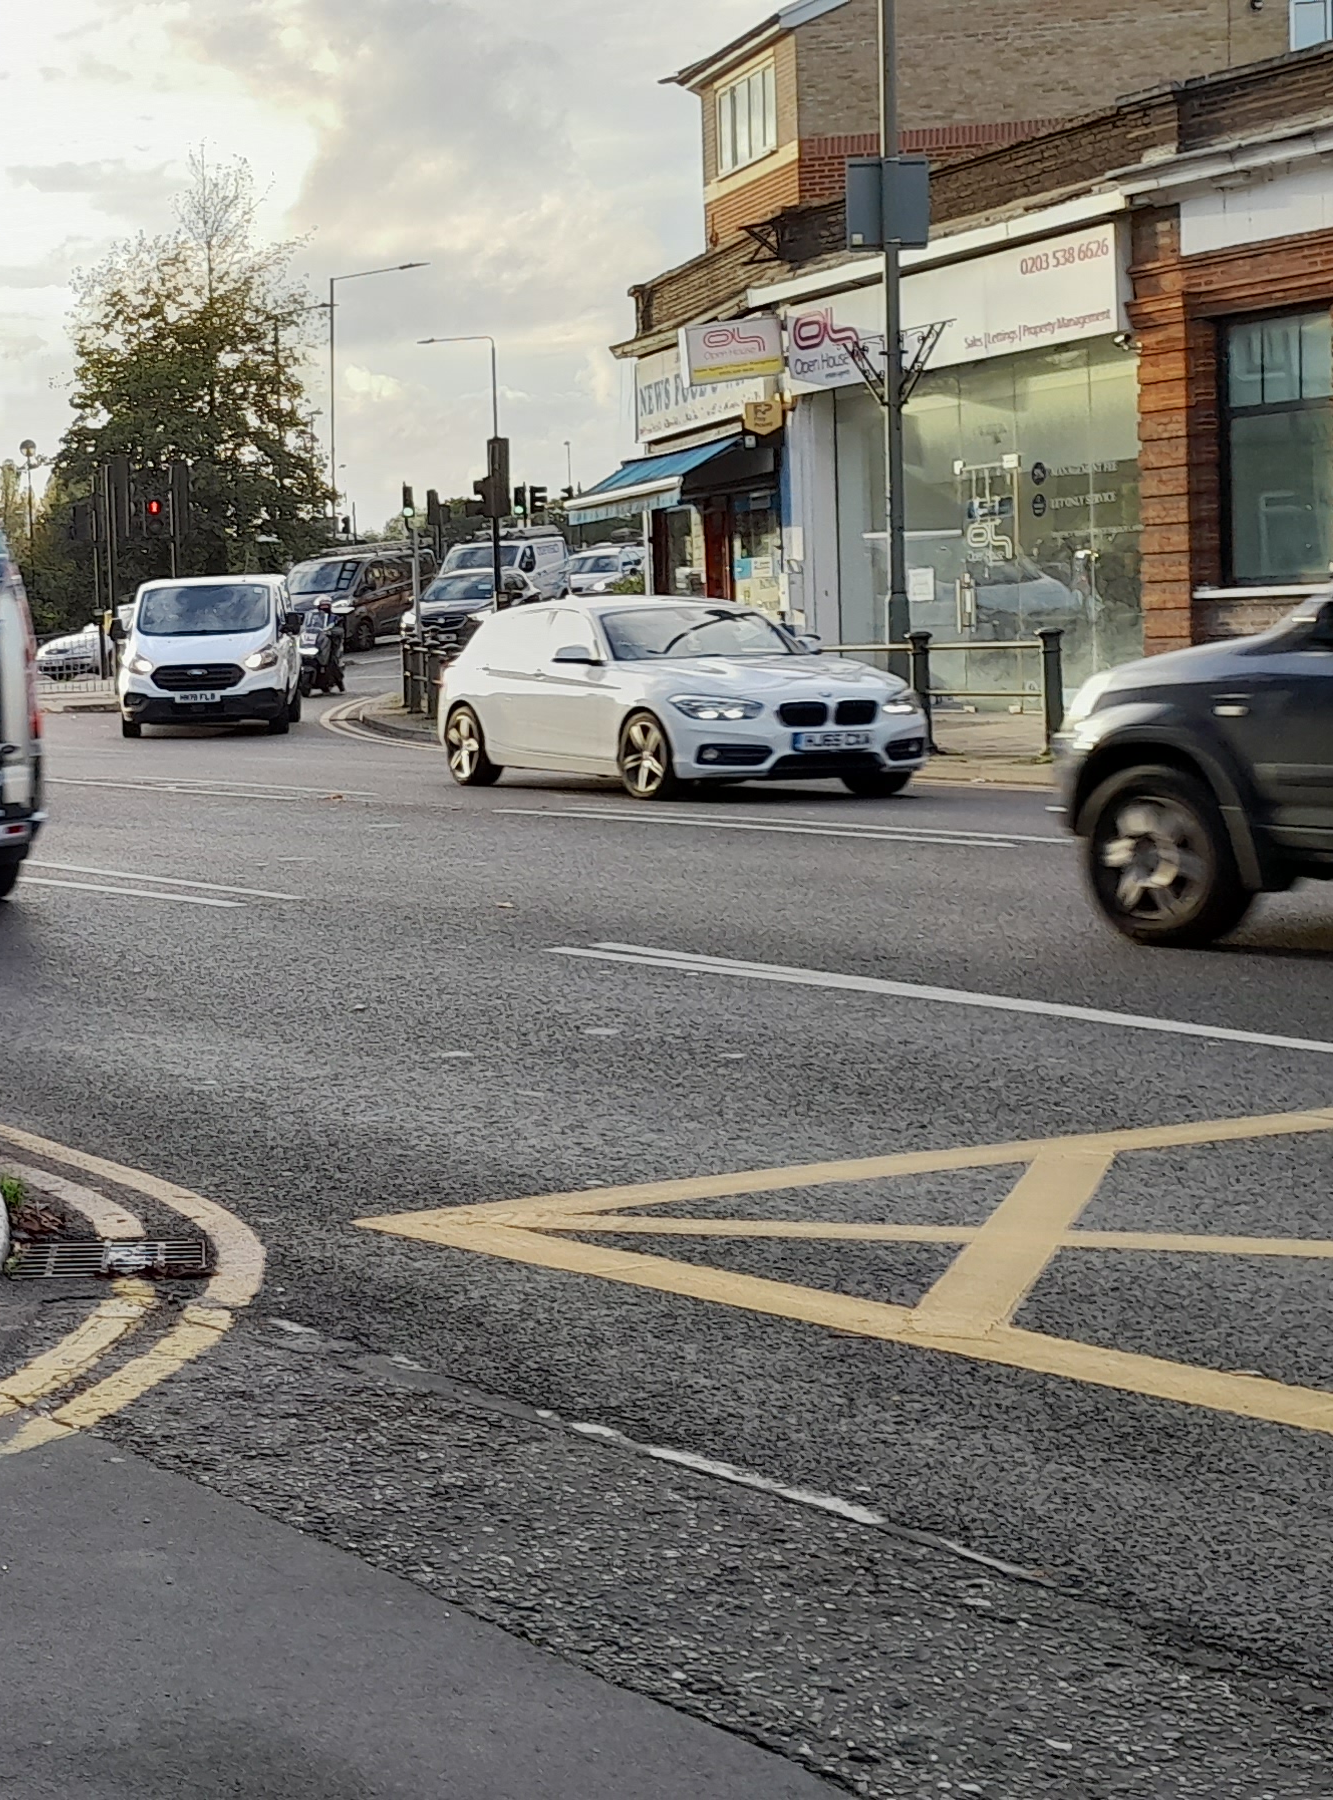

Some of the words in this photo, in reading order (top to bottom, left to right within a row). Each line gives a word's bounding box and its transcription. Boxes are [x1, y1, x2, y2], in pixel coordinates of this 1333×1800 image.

[1020, 252, 1050, 275] 0203
[1052, 246, 1075, 268] 538
[1077, 238, 1109, 261] 6626
[987, 329, 1019, 345] Lettings
[1023, 321, 1056, 338] Property
[1057, 309, 1111, 330] Management
[795, 356, 819, 376] Open
[639, 377, 670, 417] NEWS
